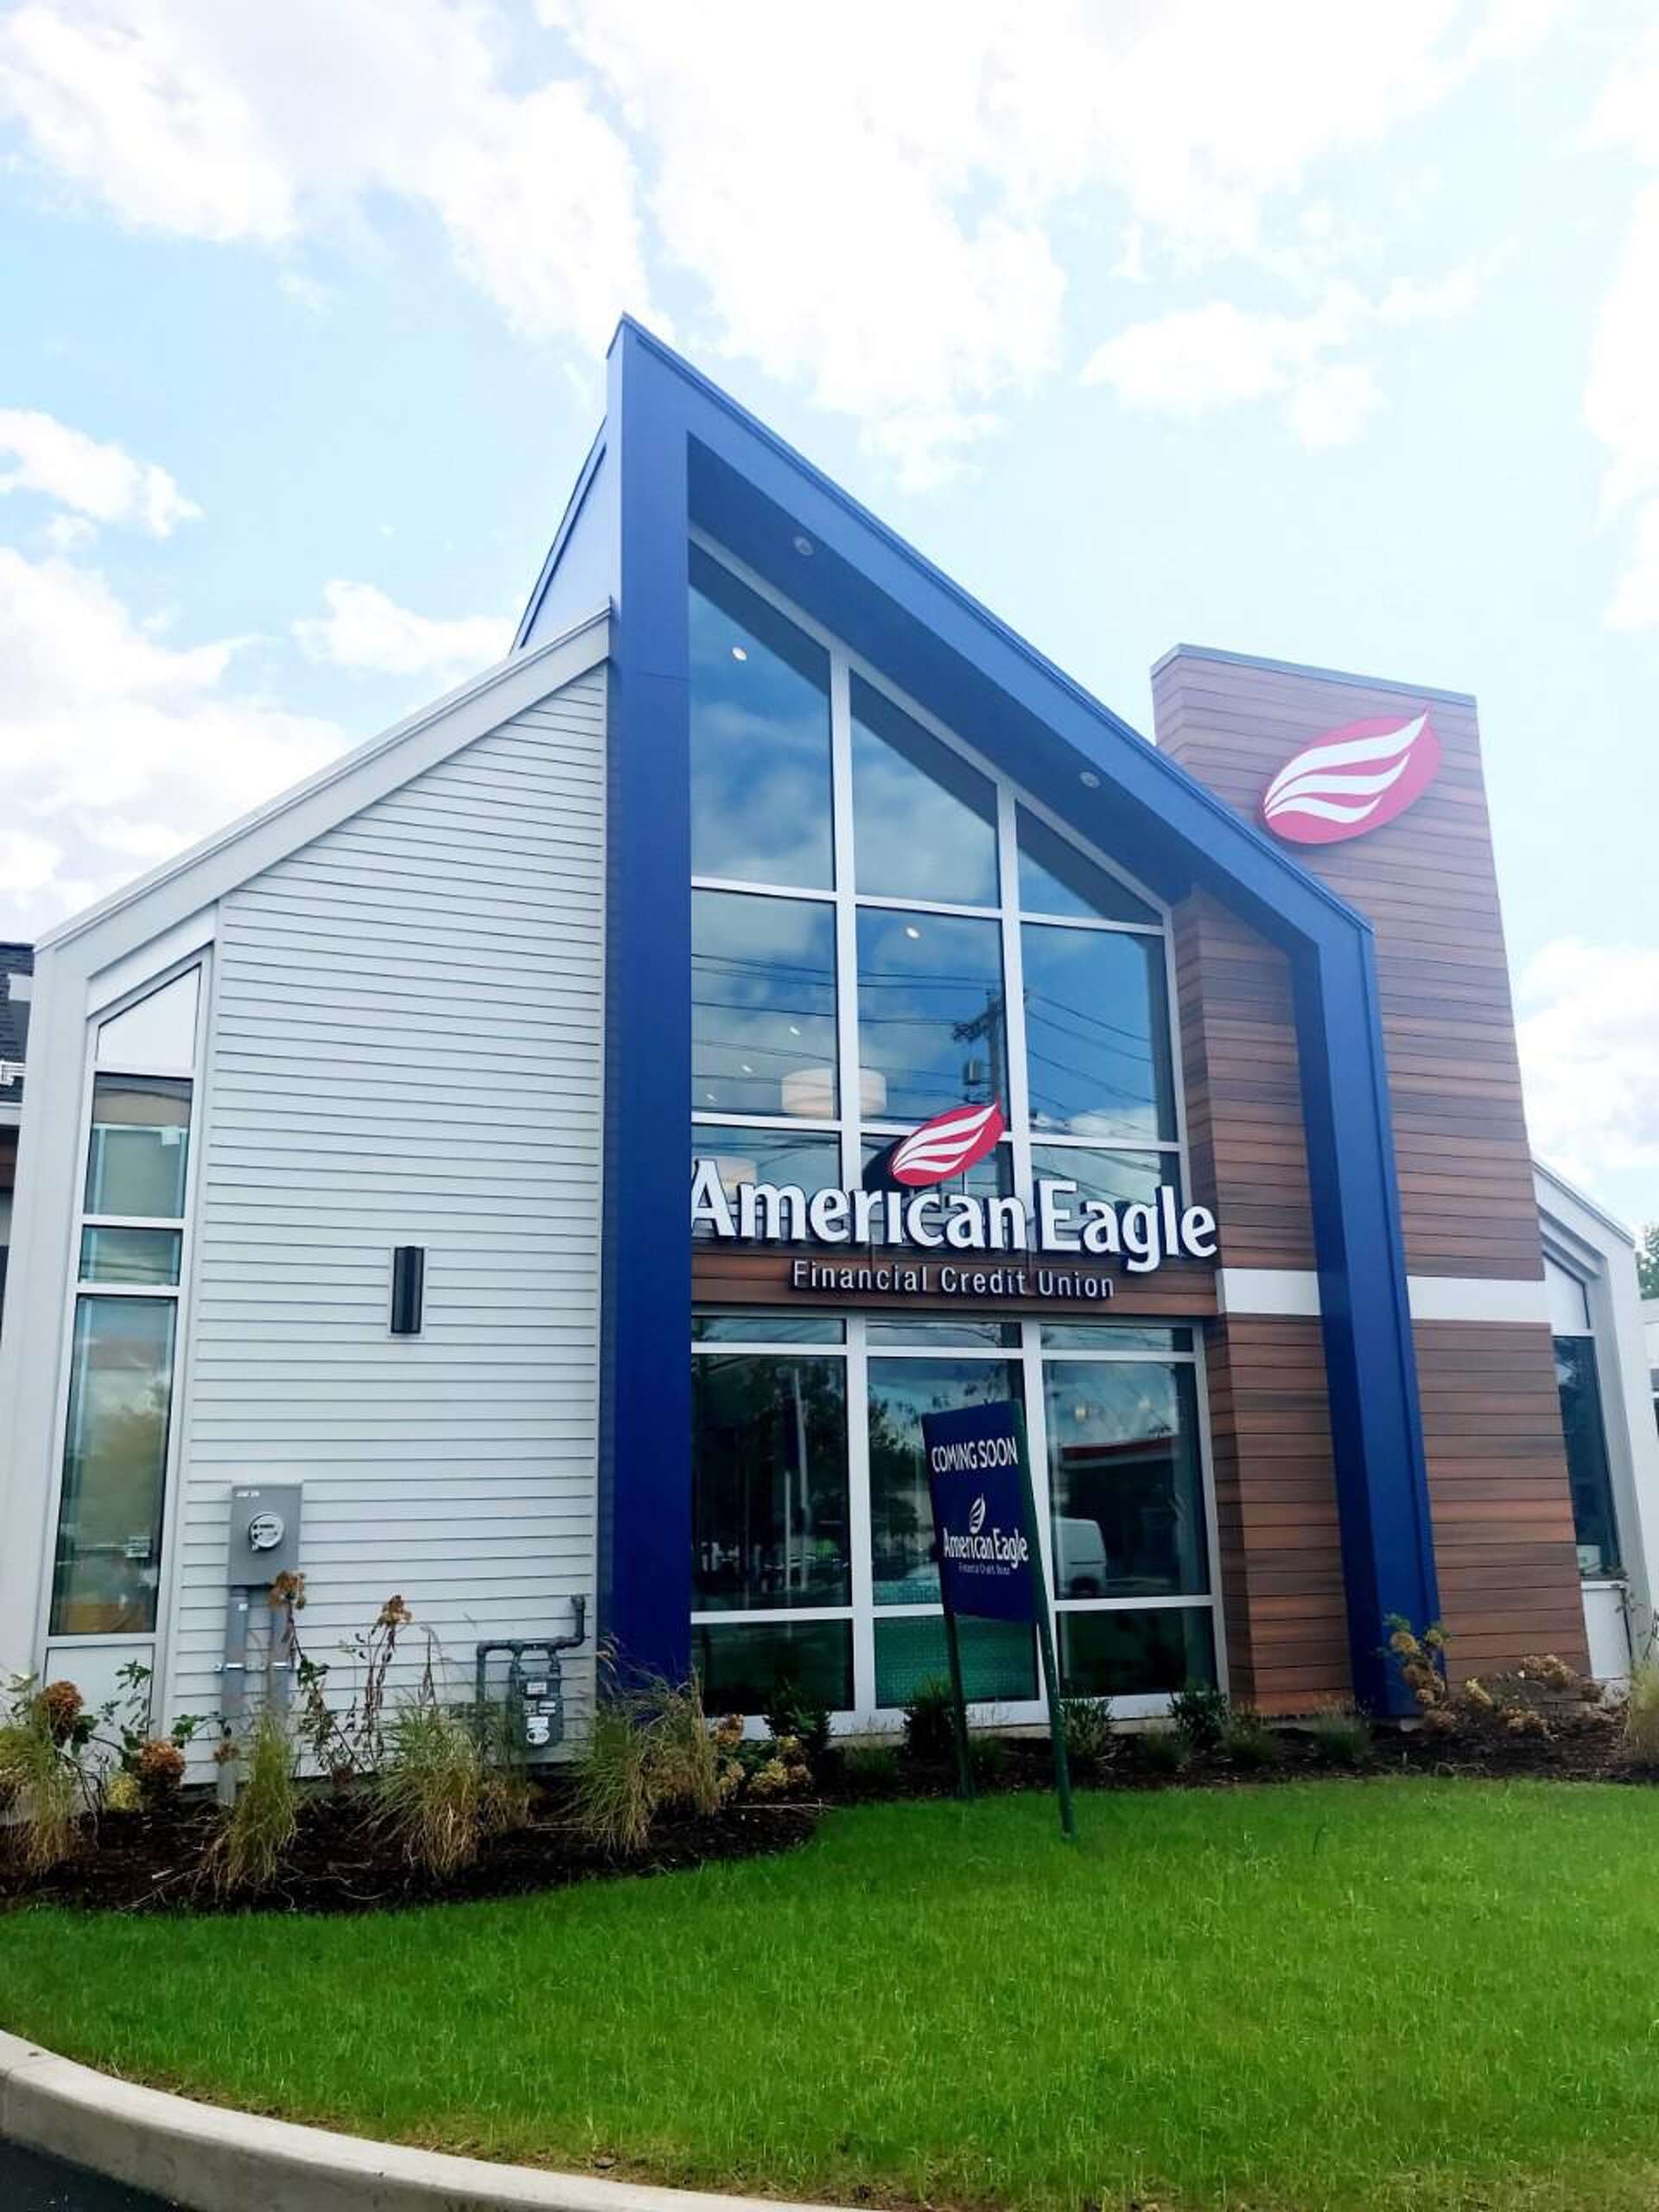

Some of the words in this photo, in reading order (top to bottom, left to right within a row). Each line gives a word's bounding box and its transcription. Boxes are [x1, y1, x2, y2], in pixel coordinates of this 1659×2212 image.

[690, 1158, 1027, 1249] American
[1039, 1179, 1217, 1273] Eagle
[793, 1260, 928, 1292] Financial
[940, 1266, 1027, 1294] Credit
[1039, 1270, 1115, 1297] Union
[931, 1442, 977, 1472] COMING
[978, 1436, 1019, 1468] SOON
[943, 1527, 995, 1560] American
[992, 1528, 1029, 1569] Eagle
